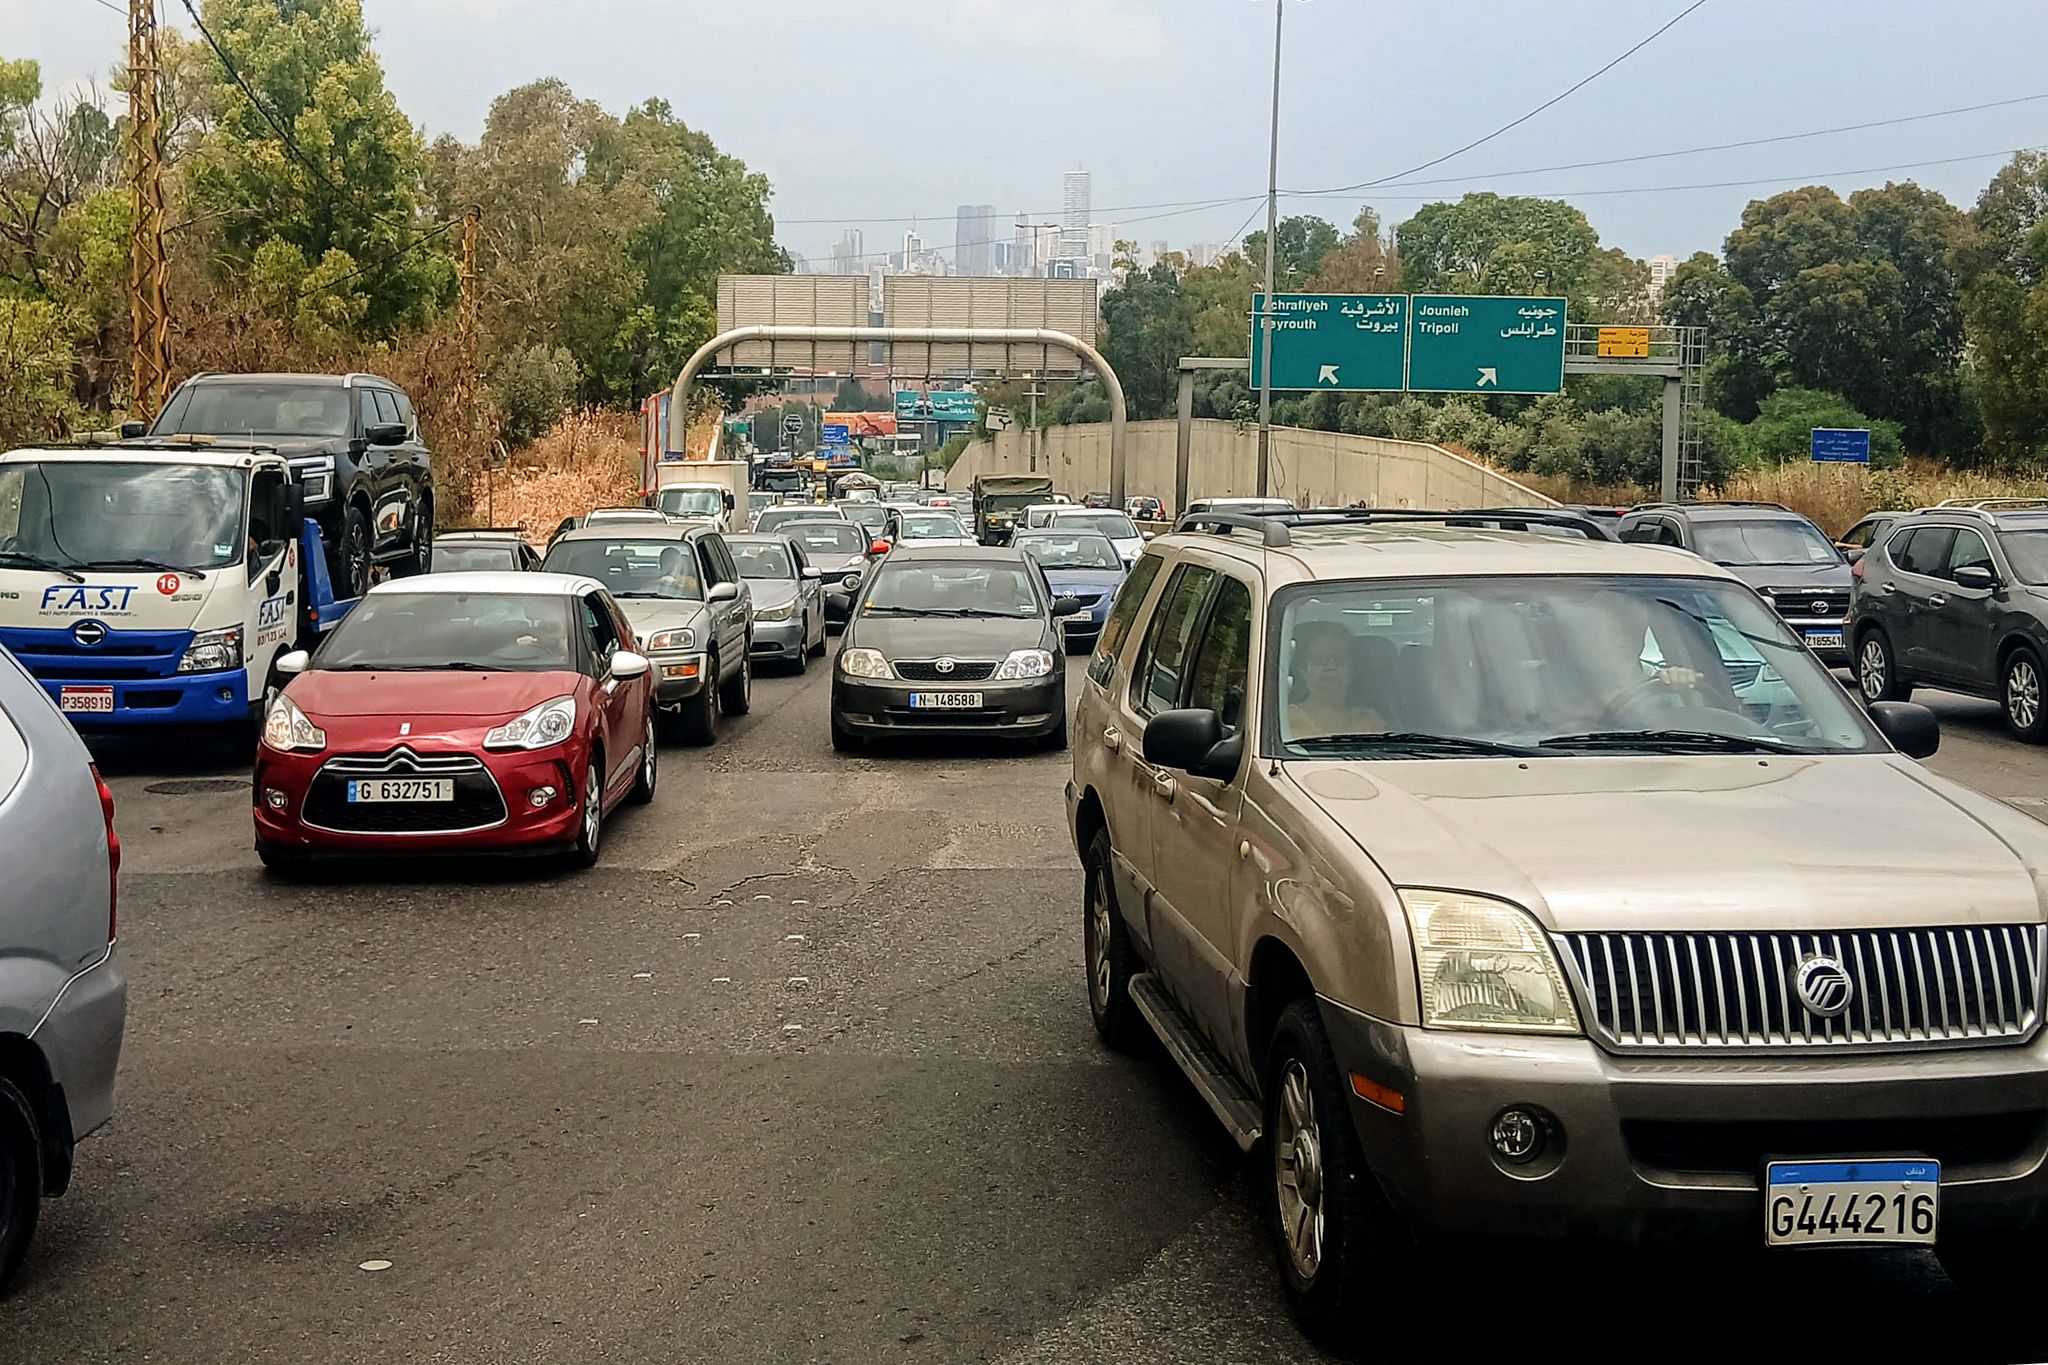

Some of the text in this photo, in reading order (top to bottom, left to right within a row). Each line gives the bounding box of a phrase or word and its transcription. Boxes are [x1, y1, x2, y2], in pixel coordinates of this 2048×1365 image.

[1340, 298, 1399, 317] الأشرفية
[1419, 305, 1469, 317] Jounieh
[1517, 305, 1558, 319] جونيه
[1356, 318, 1399, 332] بيروت
[1419, 322, 1459, 335] Tripoli
[1500, 322, 1557, 338] طرابلس
[160, 578, 177, 590] 16
[40, 585, 138, 610] F.A.S.T
[62, 696, 112, 709] P358919
[919, 694, 927, 706] N
[361, 782, 440, 799] G 632751
[1905, 1167, 1926, 1176] لبنان
[1772, 1194, 1934, 1237] G444216
